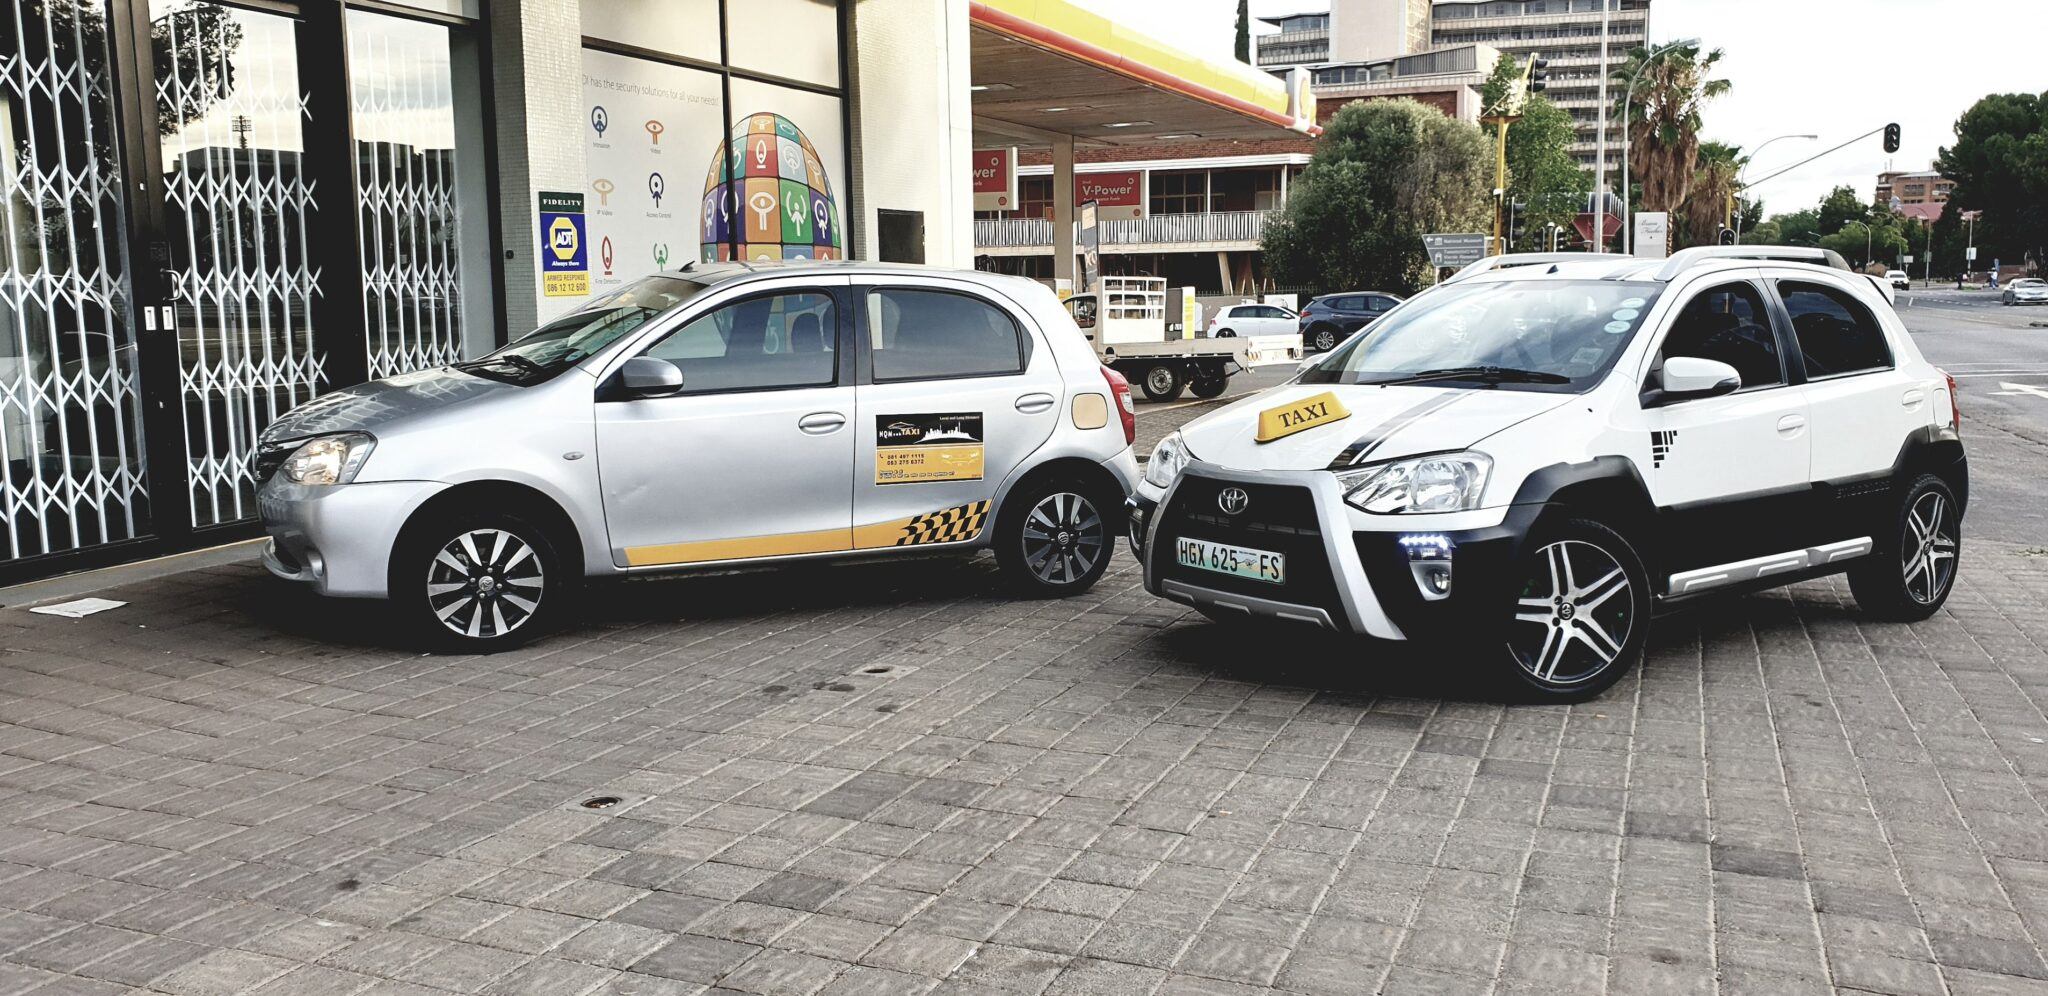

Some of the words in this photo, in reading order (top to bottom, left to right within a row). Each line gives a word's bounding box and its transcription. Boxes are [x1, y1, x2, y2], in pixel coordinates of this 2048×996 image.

[590, 77, 602, 88] has
[603, 79, 615, 90] the
[616, 81, 641, 95] security
[641, 84, 669, 98] solutions
[670, 89, 678, 100] for
[687, 93, 700, 103] your
[1083, 184, 1132, 196] V-Power
[543, 198, 582, 206] FIDELITY
[555, 231, 573, 246] ADT
[552, 260, 568, 268] Always
[547, 283, 558, 293] 086
[559, 283, 567, 292] 12
[568, 283, 575, 292] 12
[576, 283, 587, 292] 600
[1278, 401, 1329, 428] TAXI
[901, 428, 920, 436] TAXI
[1180, 541, 1205, 567] HGX
[1212, 546, 1238, 572] 625
[1260, 554, 1279, 580] FS
